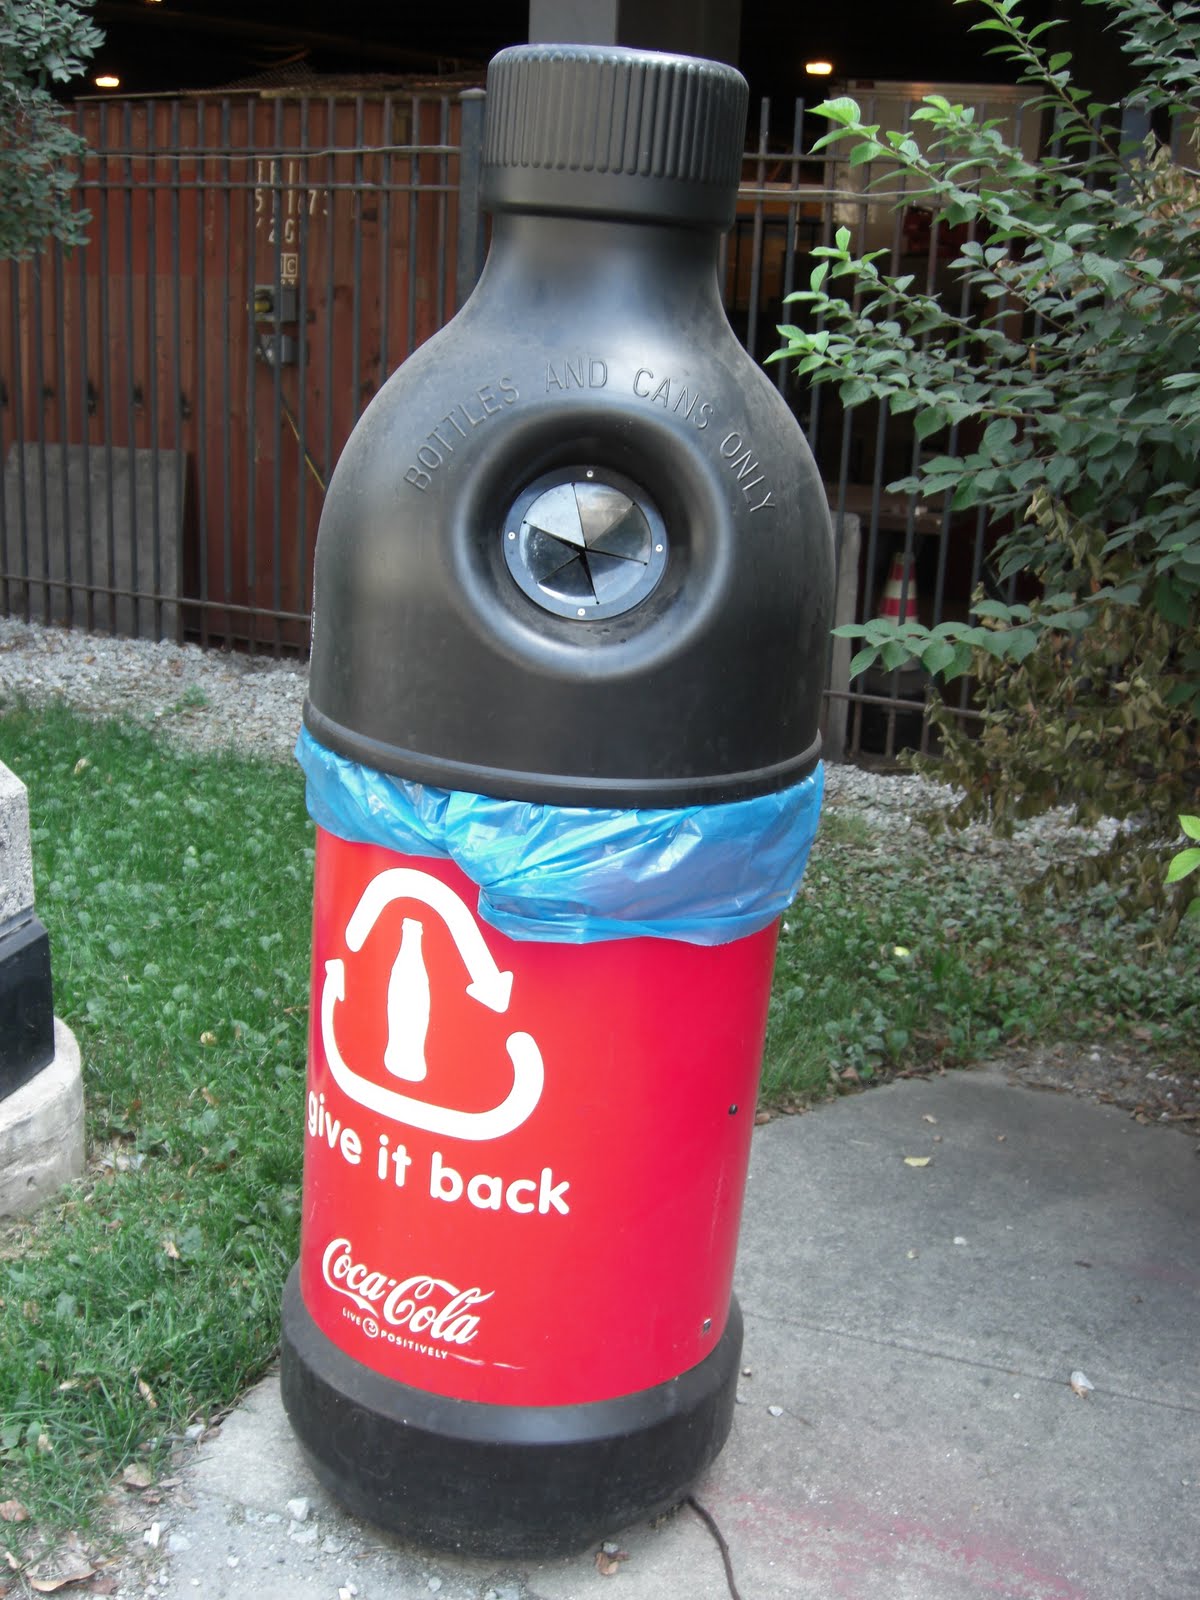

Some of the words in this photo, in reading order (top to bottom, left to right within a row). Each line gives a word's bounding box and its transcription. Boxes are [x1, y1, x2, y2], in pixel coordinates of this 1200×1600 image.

[403, 375, 520, 491] BOTTLES
[545, 358, 608, 392] AND
[633, 367, 714, 430] CANS
[720, 431, 776, 513] ONLY
[308, 1090, 362, 1165] give
[378, 1134, 412, 1187] it
[430, 1151, 570, 1215] back
[322, 1238, 496, 1345] Coca-Cola
[342, 1307, 361, 1327] LIVE
[380, 1330, 449, 1360] POSITIVELY
